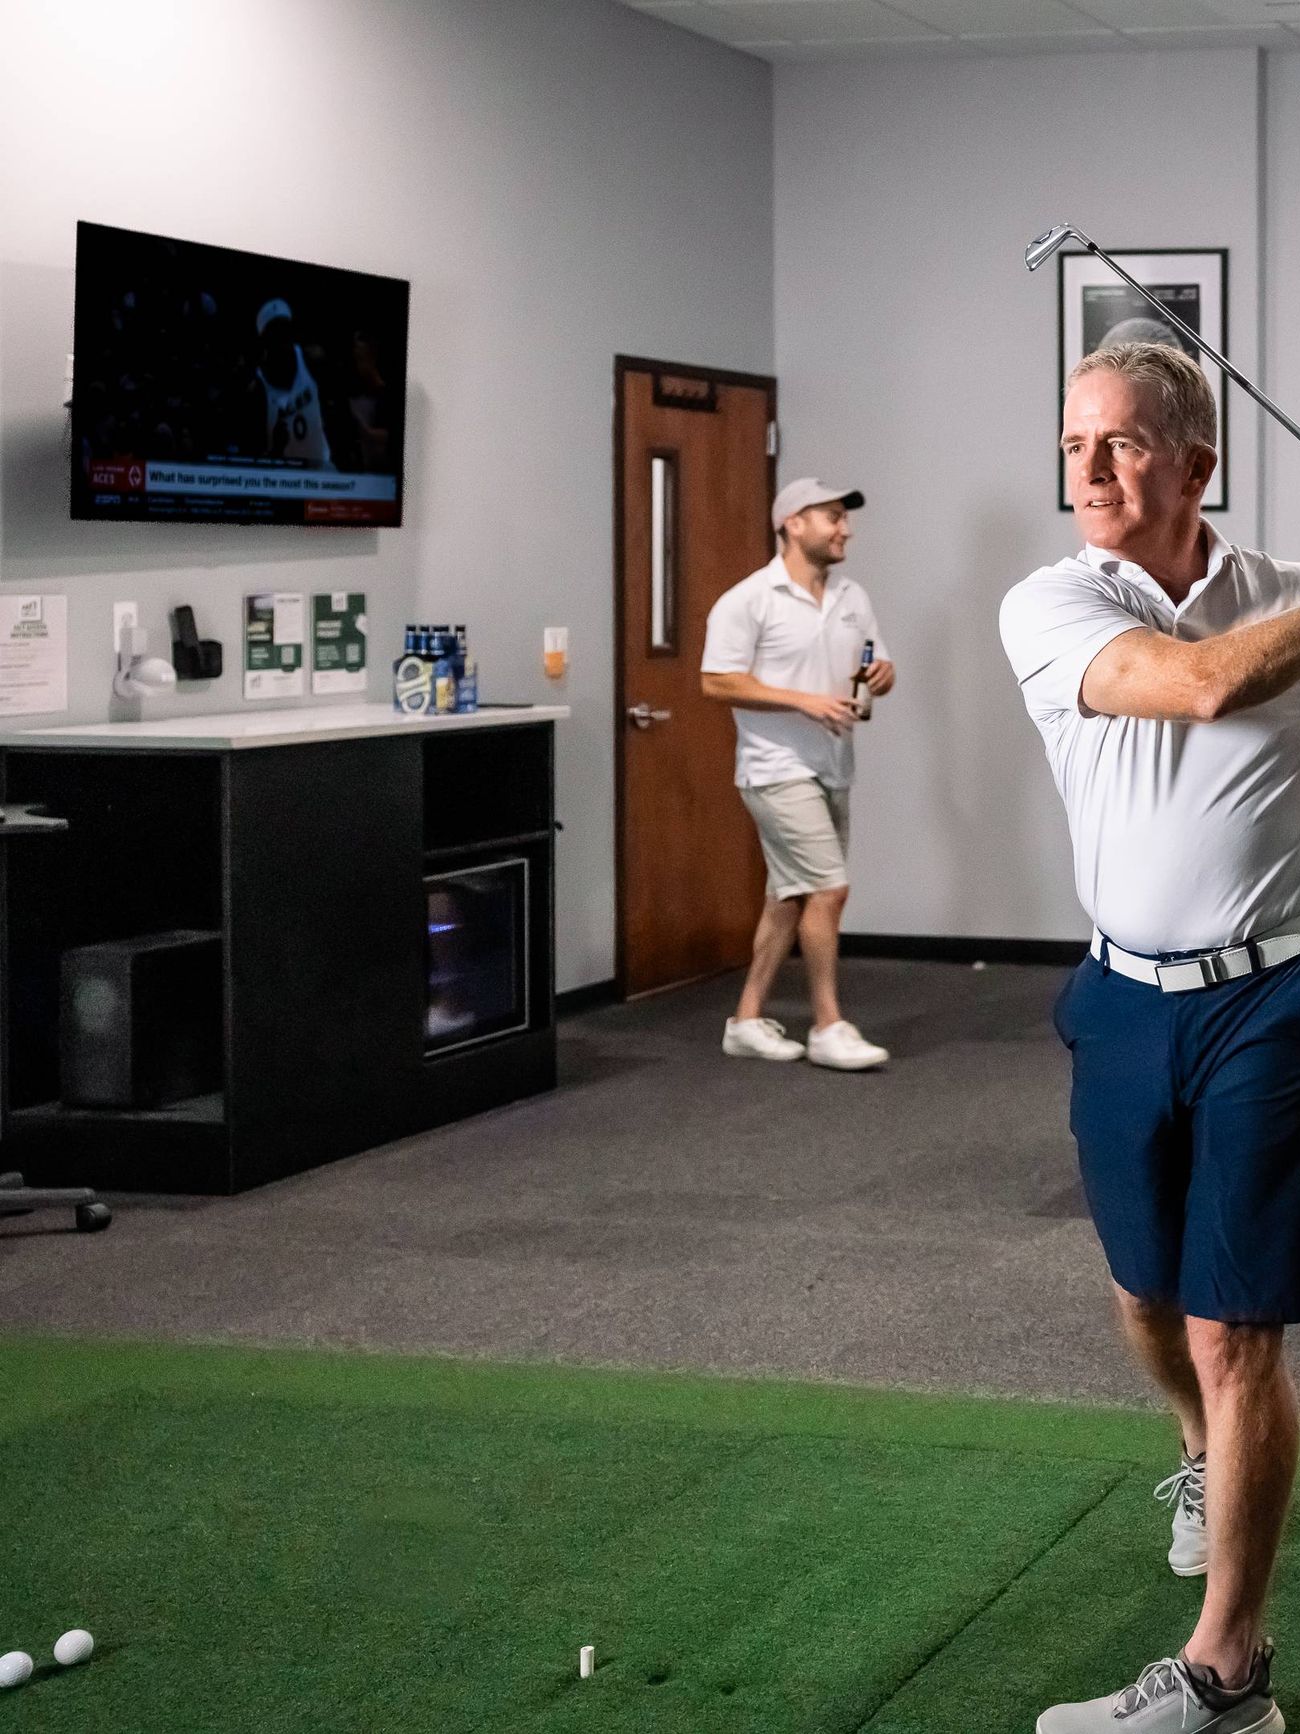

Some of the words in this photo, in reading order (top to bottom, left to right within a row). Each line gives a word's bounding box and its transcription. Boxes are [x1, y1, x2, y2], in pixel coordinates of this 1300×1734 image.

[93, 473, 115, 485] ACES
[149, 470, 175, 482] What
[178, 472, 195, 484] has
[198, 473, 242, 487] surprised
[244, 477, 261, 489] you
[262, 476, 277, 488] the
[279, 478, 301, 489] most
[303, 479, 319, 490] this
[321, 480, 356, 491] season?
